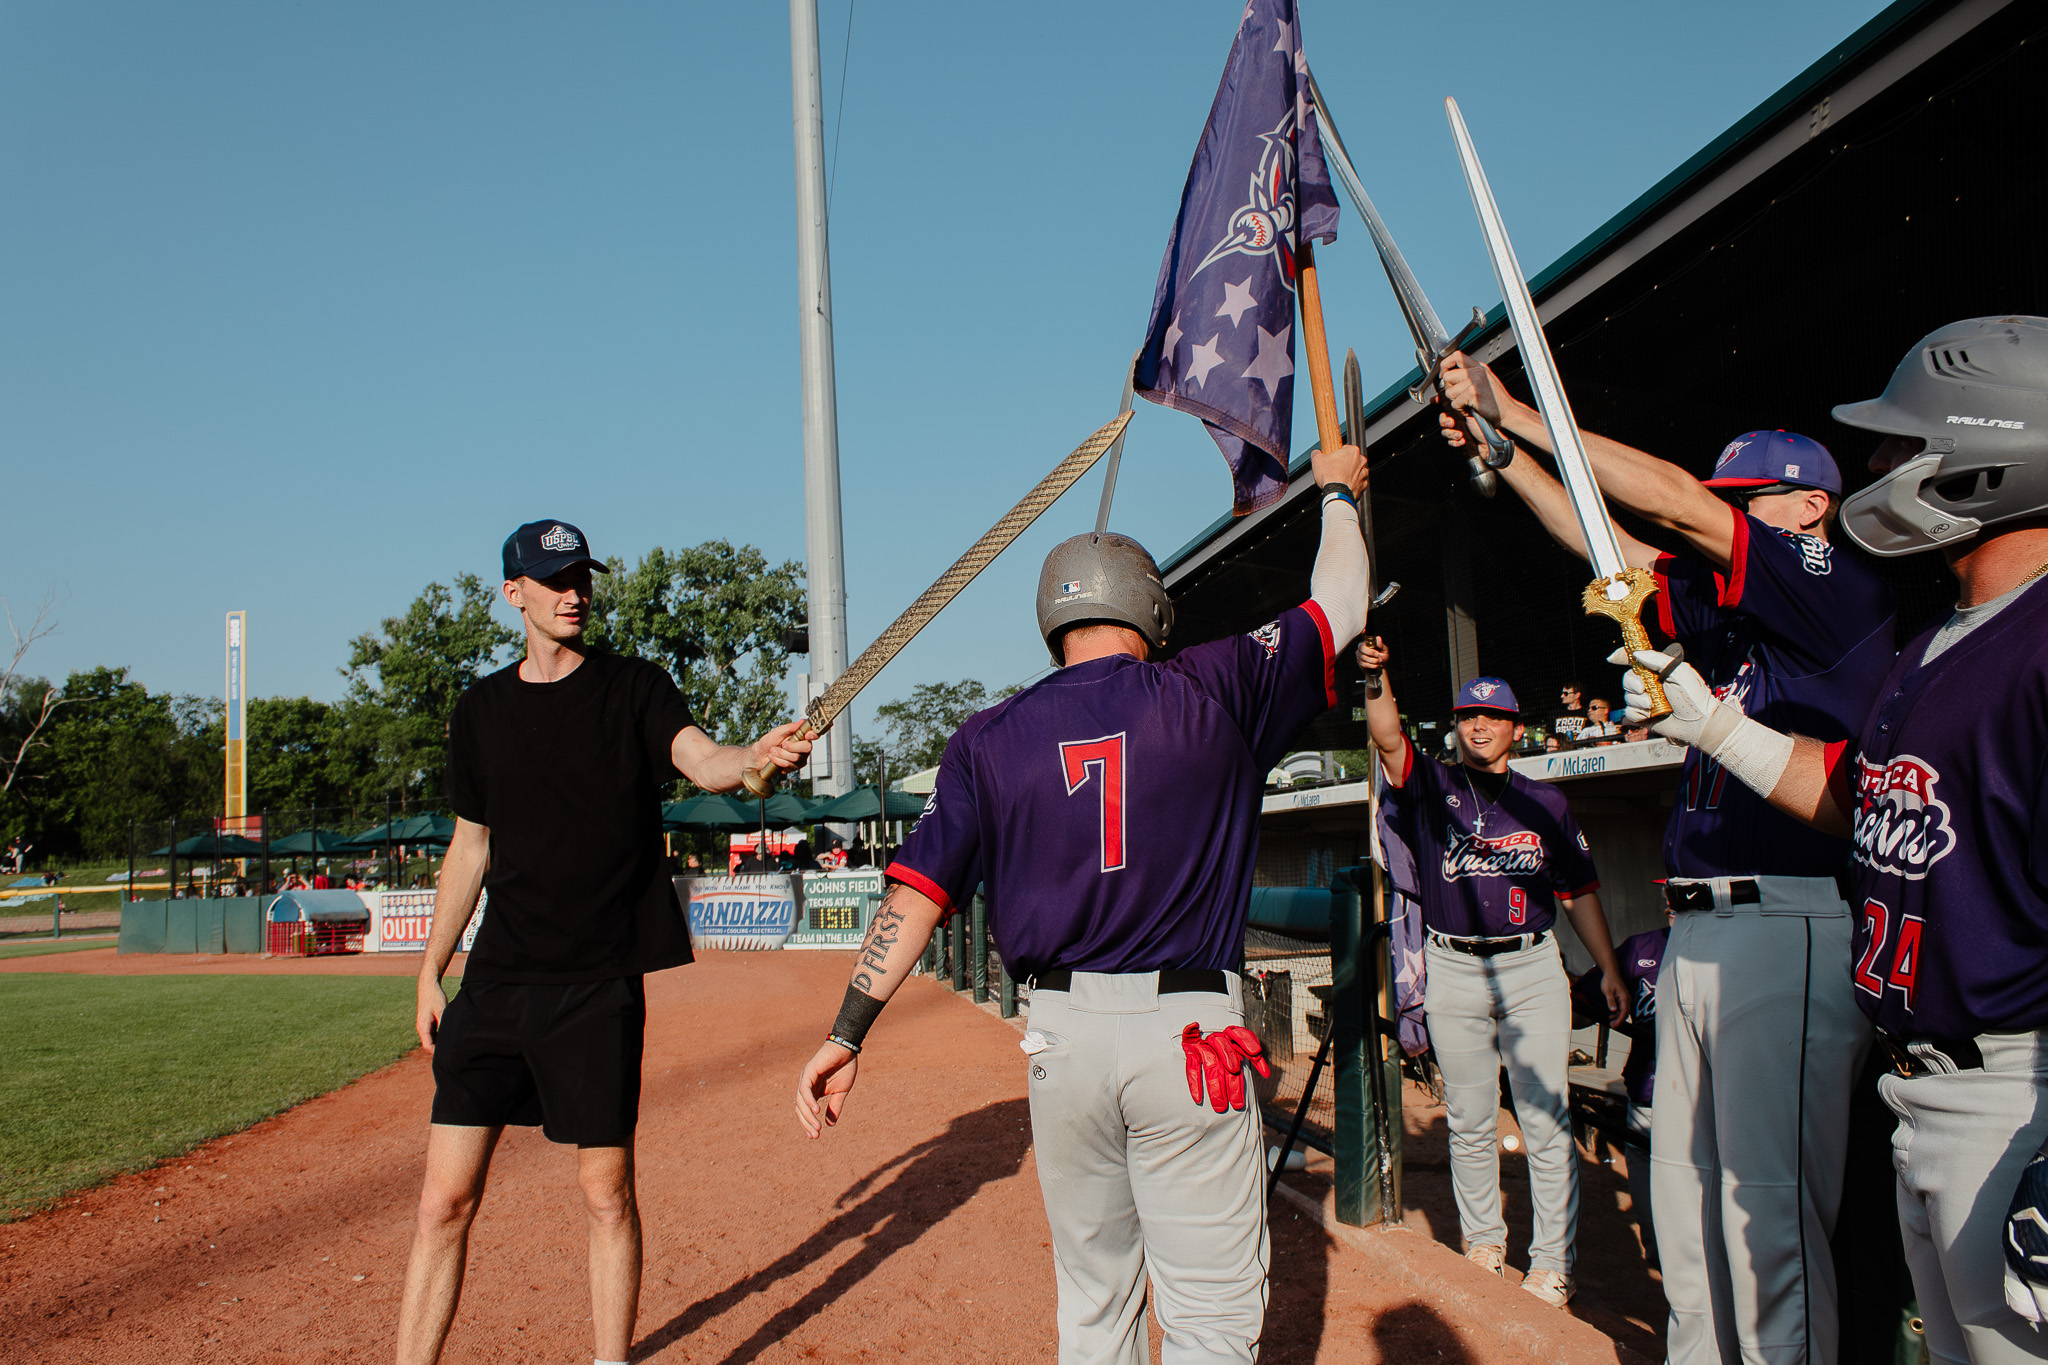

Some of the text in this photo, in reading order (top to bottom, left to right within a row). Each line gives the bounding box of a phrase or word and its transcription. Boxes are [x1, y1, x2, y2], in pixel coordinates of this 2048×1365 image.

[1946, 415, 2025, 430] RAWLINGS
[545, 533, 578, 546] USPBL
[1054, 591, 1093, 605] RAWLINGS
[1562, 756, 1605, 777] McLaren
[1058, 731, 1126, 873] 7
[1474, 835, 1532, 849] UTICA
[1445, 842, 1541, 876] Unicorns
[809, 882, 846, 894] JOHNS
[848, 880, 878, 894] FIELD
[808, 897, 861, 908] TECHS AT BAT
[1508, 886, 1527, 925] 9
[383, 918, 433, 939] OUTLE
[689, 901, 793, 935] RANDAZZO
[792, 933, 865, 943] TEAM IN THE LEAG
[861, 905, 906, 975] FIRST
[1855, 897, 1926, 1015] 24
